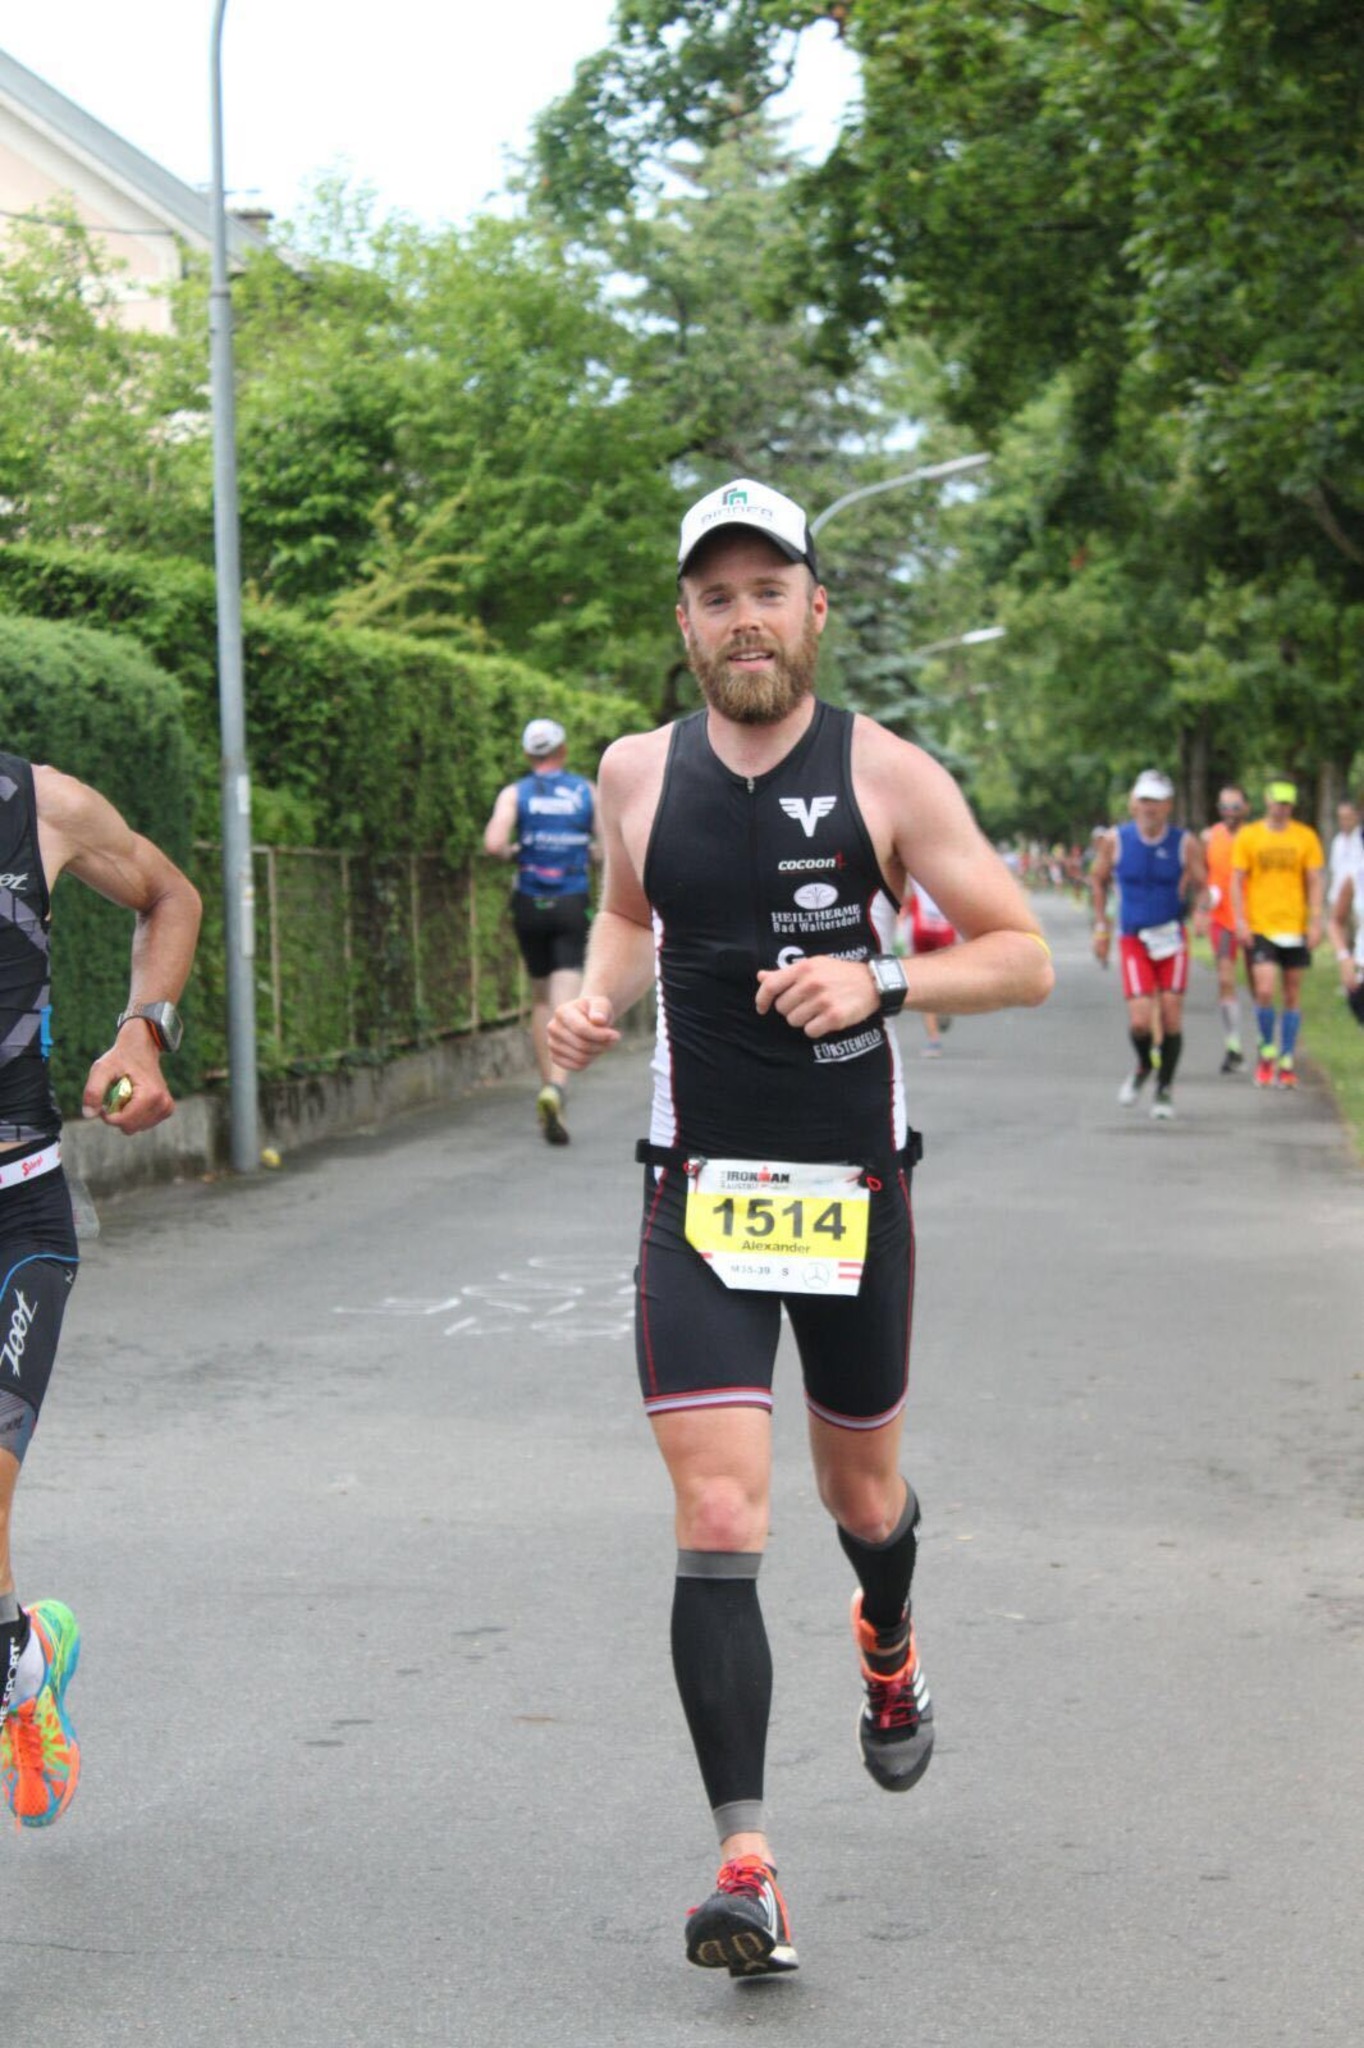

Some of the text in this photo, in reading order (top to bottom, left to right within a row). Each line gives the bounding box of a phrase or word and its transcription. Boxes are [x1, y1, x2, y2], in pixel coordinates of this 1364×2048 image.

[777, 858, 836, 871] cocoon
[771, 904, 861, 923] HEILTHERME
[773, 914, 861, 933] Bad Waltersdorf
[713, 1198, 847, 1241] 1514
[741, 1241, 812, 1254] Alexander
